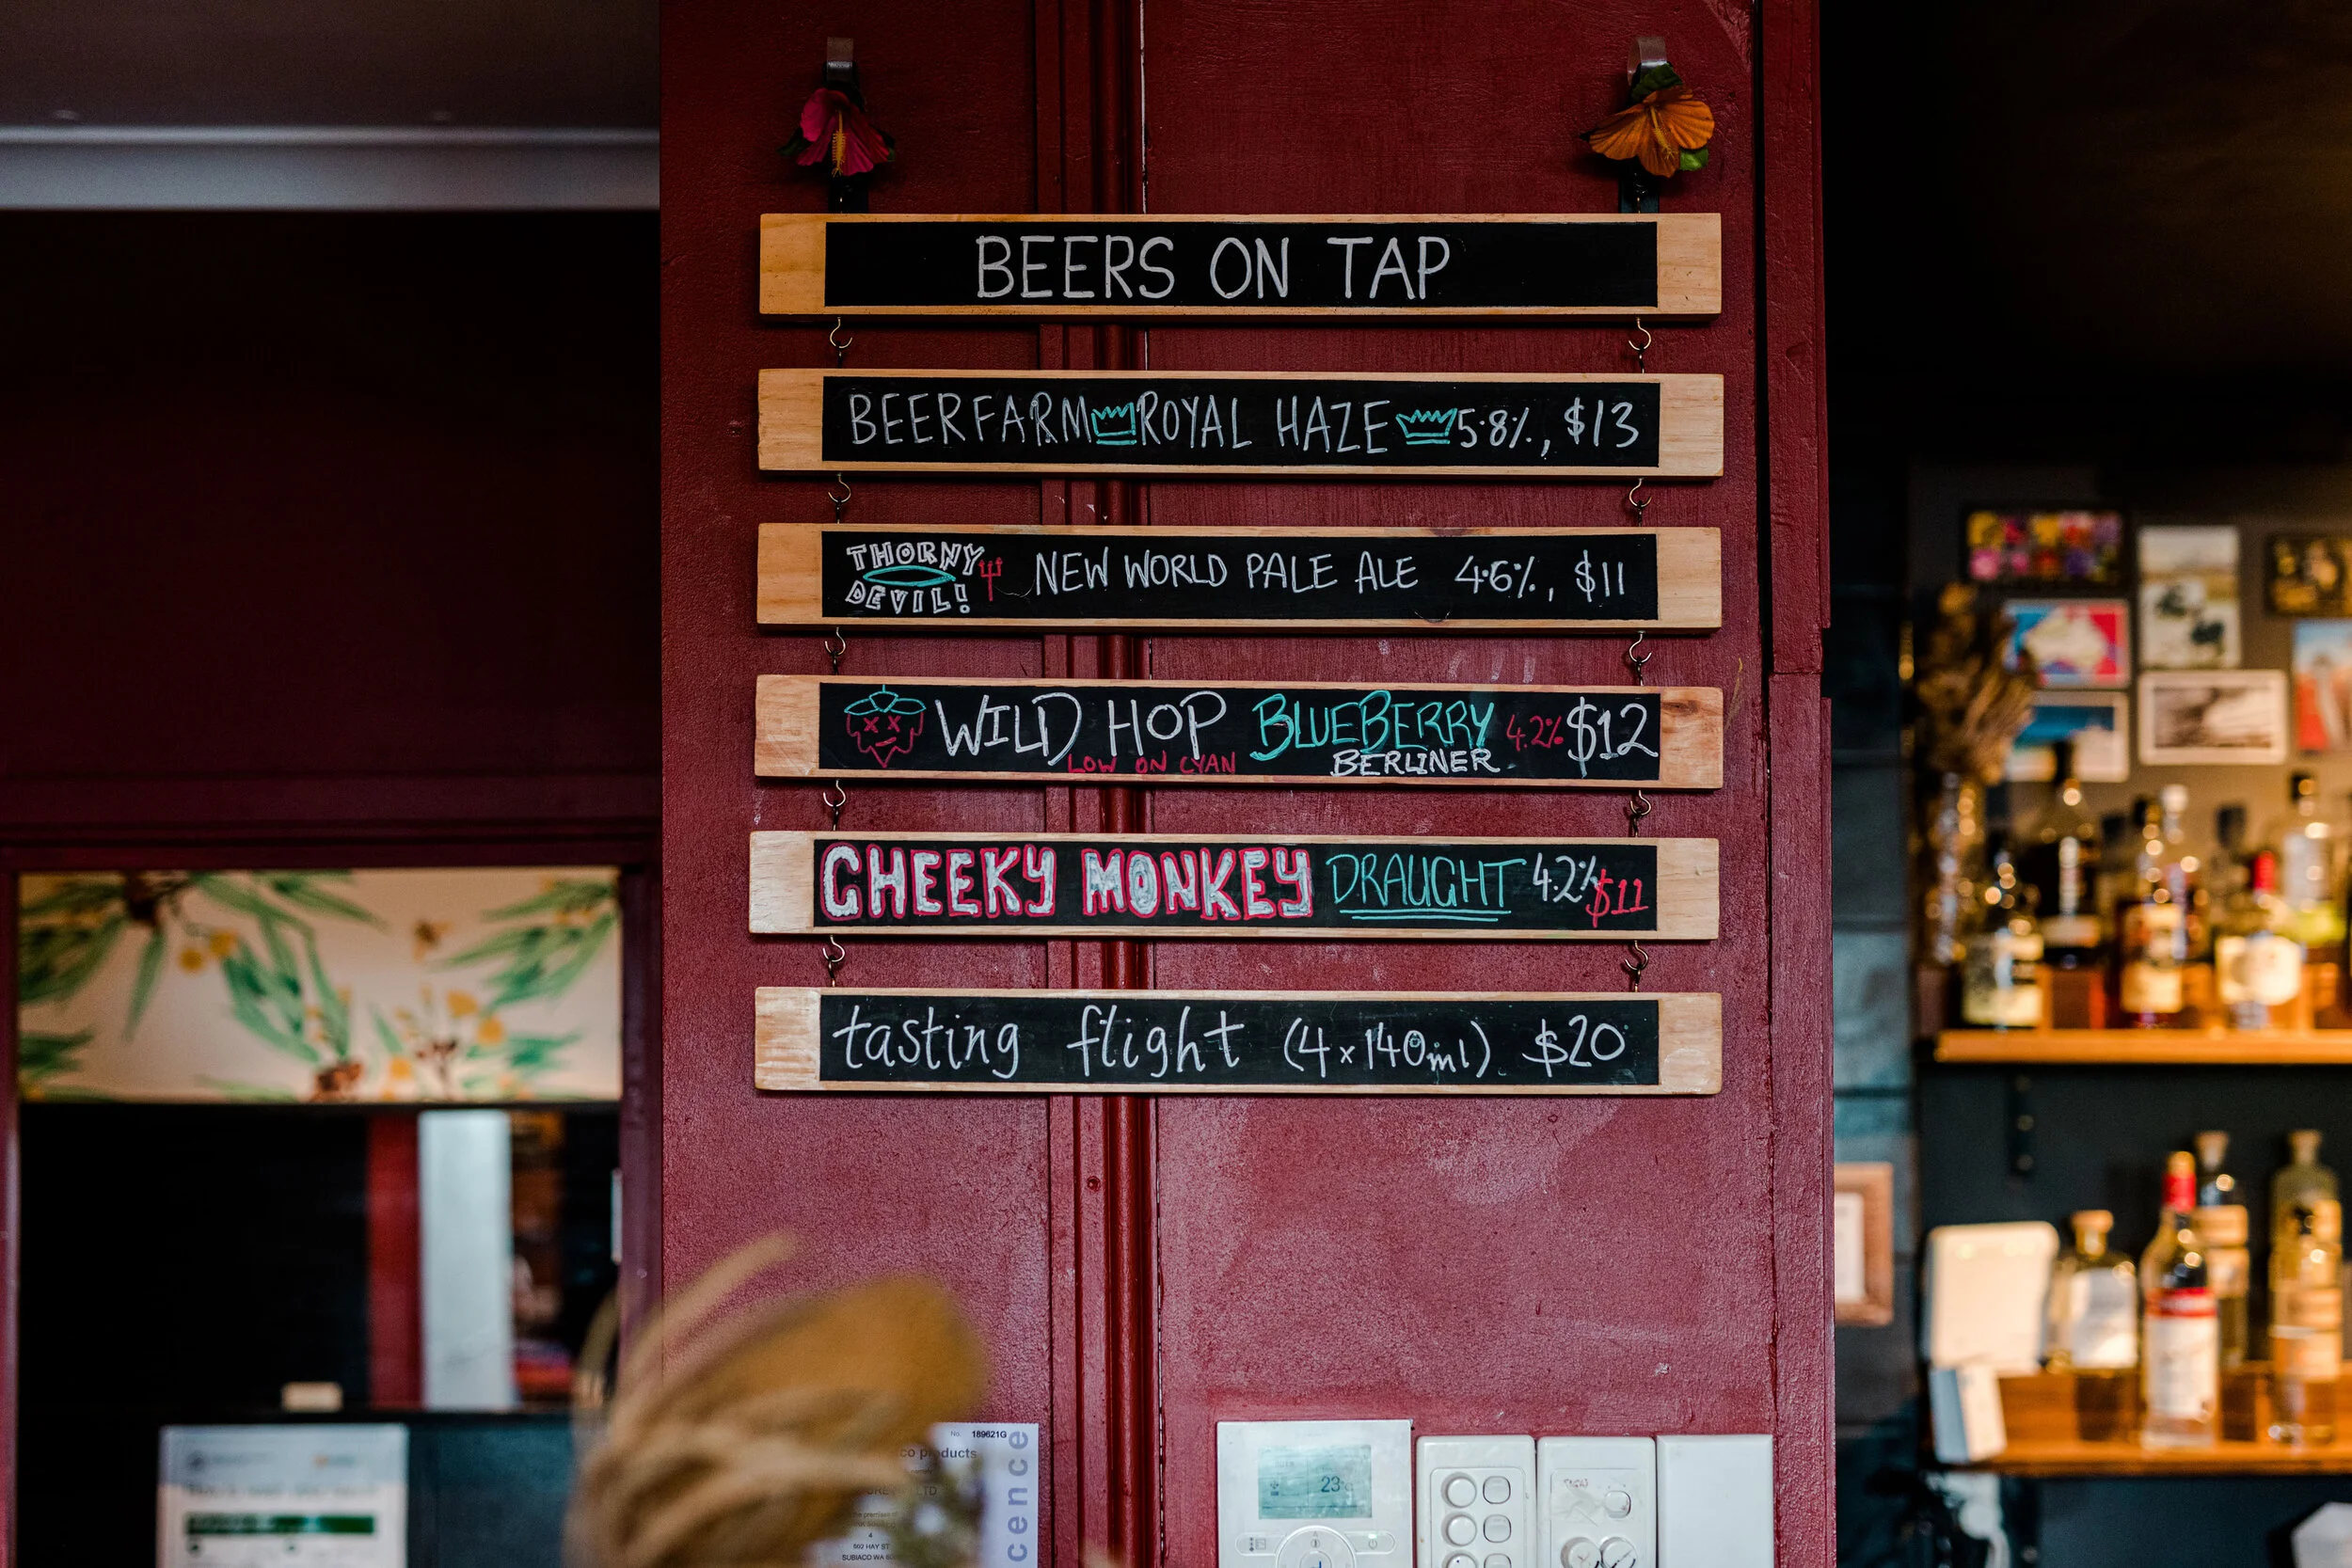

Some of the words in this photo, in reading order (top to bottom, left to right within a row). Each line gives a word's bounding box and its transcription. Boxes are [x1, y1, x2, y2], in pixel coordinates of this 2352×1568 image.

[976, 235, 1175, 299] BEERS
[1210, 236, 1289, 299] ON
[1327, 236, 1451, 299] TAP
[850, 391, 1092, 445] BEERFARM
[1136, 390, 1252, 449] ROYAL
[1277, 395, 1391, 453] HAZE
[1564, 397, 1640, 448] $13
[846, 541, 985, 577] THORNY
[1035, 546, 1109, 595] NEW
[1123, 549, 1228, 588] WORLD
[1247, 552, 1338, 594] PALE
[1355, 551, 1419, 594] ALE
[1574, 549, 1625, 603] $11
[845, 579, 971, 614] DEVIL!
[935, 692, 1083, 766] WILD
[1108, 690, 1227, 760] HOP
[1506, 714, 1565, 752] 4.2%
[1565, 696, 1660, 779] $12
[1067, 752, 1118, 774] LOW
[1135, 752, 1168, 774] ON
[1179, 752, 1236, 774] CYAN
[1329, 748, 1502, 778] BERLINER
[819, 842, 1057, 920] CHEEKY
[1081, 847, 1313, 920] MONKEY
[1325, 852, 1528, 908] DRAUGHT
[1585, 868, 1649, 928] $11
[833, 1005, 1020, 1079] tasting
[1066, 1005, 1246, 1078] flight
[1521, 1014, 1626, 1078] $20
[919, 1447, 978, 1460] pducts
